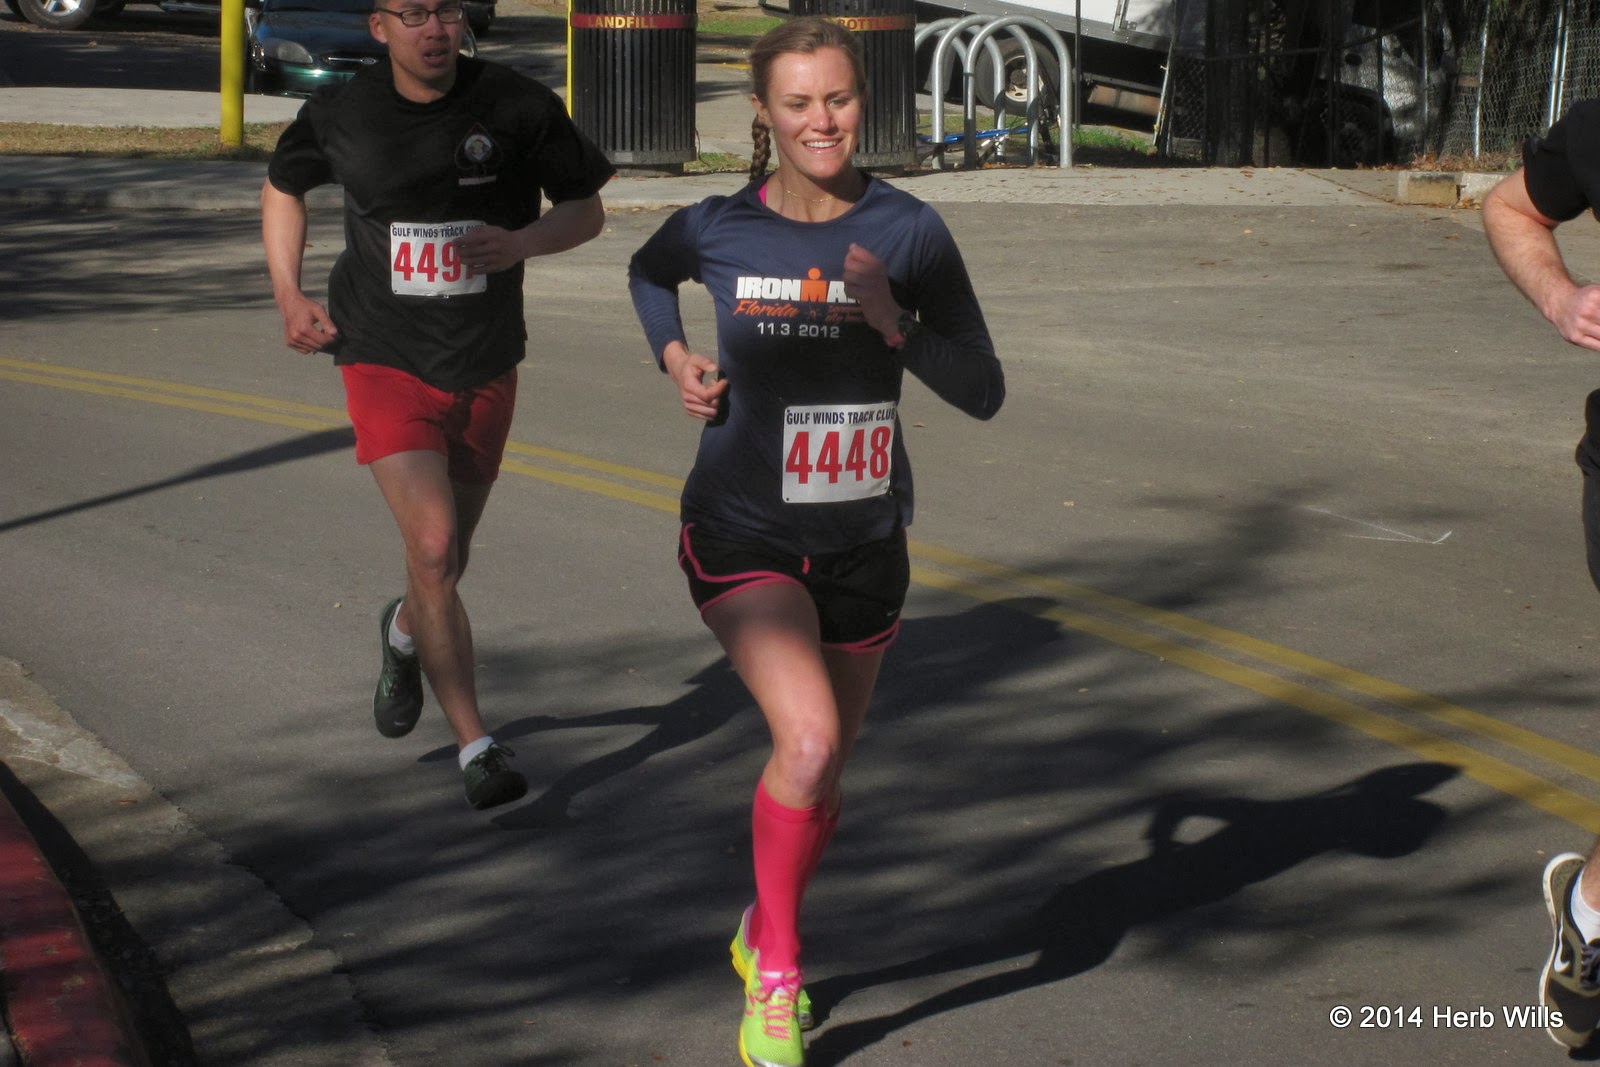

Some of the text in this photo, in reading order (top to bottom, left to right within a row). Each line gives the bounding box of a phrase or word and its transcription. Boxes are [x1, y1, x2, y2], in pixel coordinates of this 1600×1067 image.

[588, 16, 657, 29] LANDFILL
[392, 227, 411, 238] GULF
[413, 228, 439, 238] WINDS
[440, 225, 465, 238] TRACK
[736, 267, 861, 304] IRONMA
[732, 299, 799, 318] Florida
[786, 407, 897, 425] GULF WINDS TRACK CLUB
[785, 425, 892, 485] 4448
